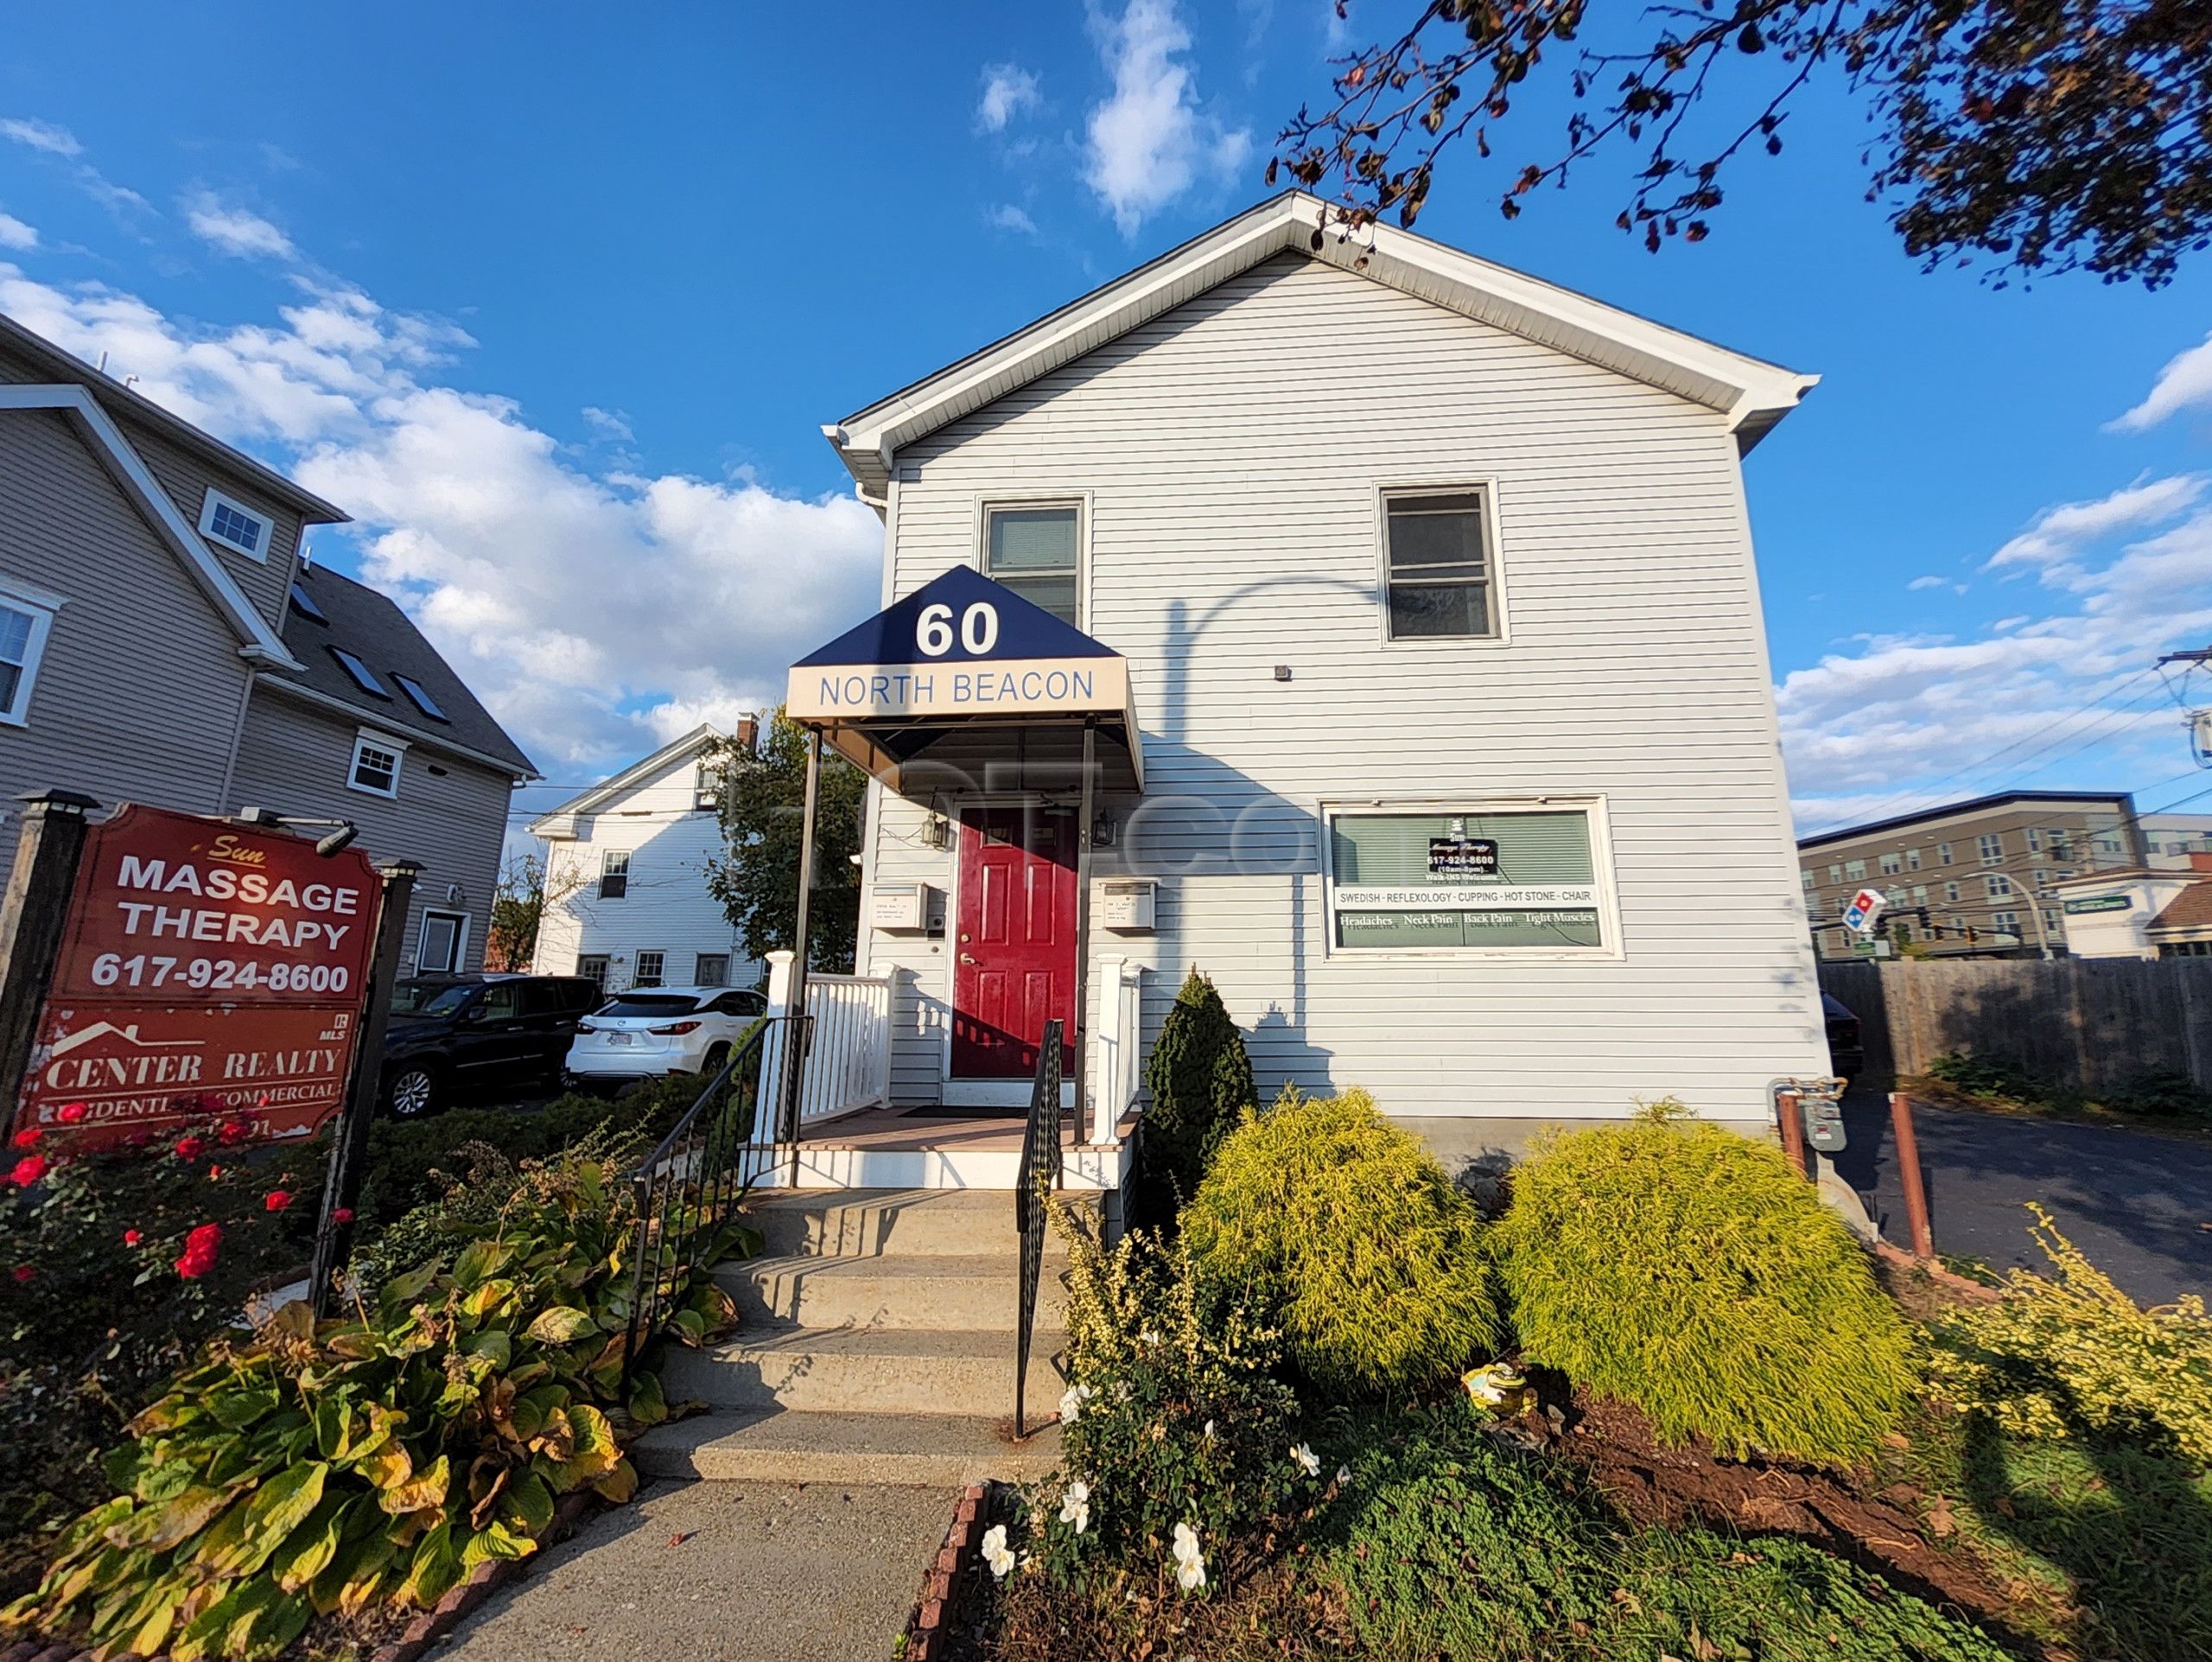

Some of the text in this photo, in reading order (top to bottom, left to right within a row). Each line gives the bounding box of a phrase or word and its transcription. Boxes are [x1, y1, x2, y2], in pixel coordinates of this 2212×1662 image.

[916, 602, 999, 656] 60
[819, 670, 1093, 706] NORTH BEACON
[208, 835, 265, 863] Sun
[1427, 856, 1494, 864] 617-924-8600
[118, 855, 359, 915] MASSAGE
[1340, 893, 1380, 902] SWEDISH
[1387, 892, 1452, 902] REFLEXOLOGY
[1458, 892, 1498, 901] CUPPING
[1504, 891, 1522, 901] HOT
[1525, 891, 1555, 901] STONE
[1562, 891, 1592, 901] CHAIR
[118, 901, 350, 951] THERAPY
[1340, 912, 1596, 926] Headaches Neck Pain Back Pain Tight Muscles
[92, 953, 348, 992] 617-924-8600
[318, 1030, 346, 1041] MLS
[46, 1048, 341, 1089] CENTER REALTY
